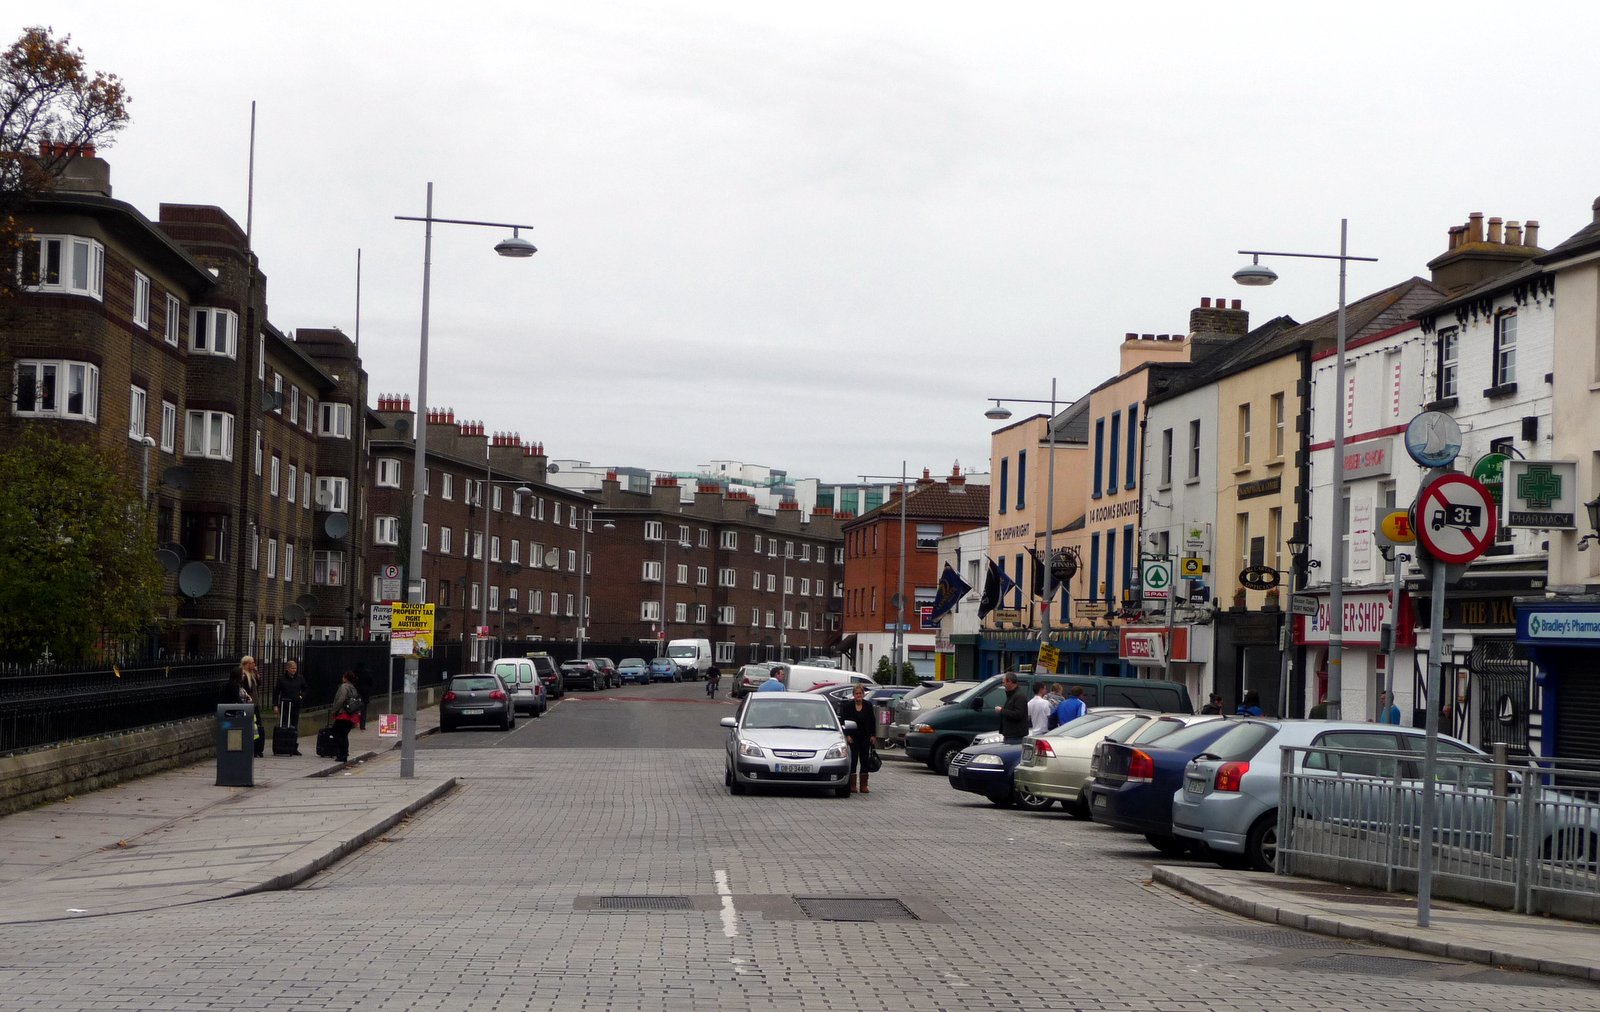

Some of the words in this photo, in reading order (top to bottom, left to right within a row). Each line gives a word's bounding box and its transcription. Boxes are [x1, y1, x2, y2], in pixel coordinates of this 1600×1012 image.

[1344, 453, 1361, 471] RBER
[1365, 449, 1384, 466] SHOP
[1478, 472, 1503, 485] Smith
[1090, 510, 1095, 523] 14
[1096, 504, 1115, 522] ROOMS
[1117, 499, 1139, 518] ENSUITE
[1454, 507, 1471, 523] 3t
[1512, 514, 1569, 523] PHARMACY
[1002, 523, 1029, 541] SHIPWRIGHT
[1320, 603, 1355, 632] BAER
[1358, 602, 1384, 632] SHOP
[1461, 602, 1486, 625] THE
[1491, 601, 1516, 625] YAC
[1541, 619, 1570, 635] Bradley's
[1572, 619, 1600, 632] Pharmac
[1131, 641, 1149, 654] SPAR
